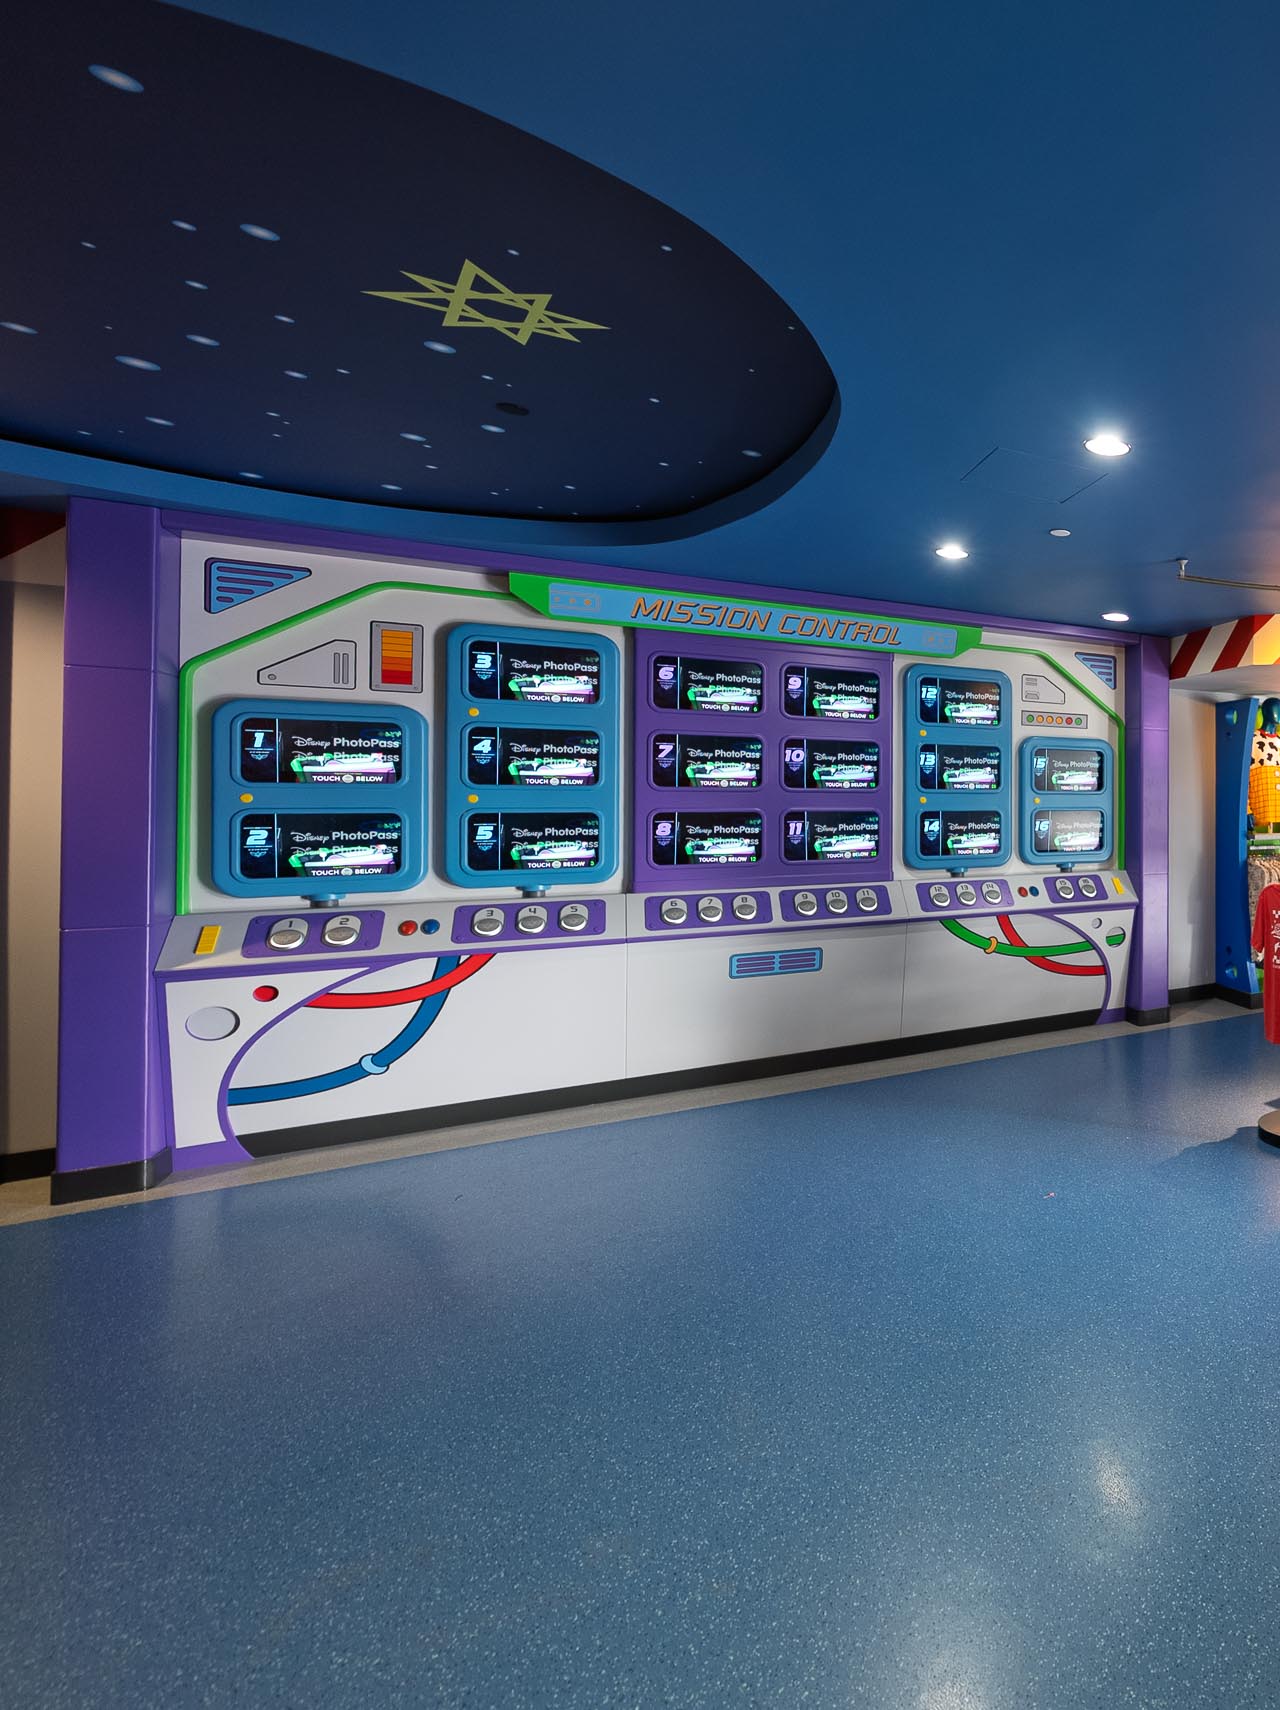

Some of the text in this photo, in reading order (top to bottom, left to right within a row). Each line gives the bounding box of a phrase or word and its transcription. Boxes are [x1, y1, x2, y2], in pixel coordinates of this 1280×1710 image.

[631, 597, 901, 645] MISSION CONTROL
[474, 654, 492, 669] 3
[510, 658, 598, 672] Disney PhotoPass
[658, 667, 675, 680] 6
[687, 671, 761, 684] Disney PhotoPass
[788, 677, 801, 690] 9
[813, 681, 877, 693] Disney PhotoPass
[527, 694, 550, 702] TOUCH
[921, 687, 938, 699] 12
[965, 692, 999, 700] PhotoPass
[254, 733, 264, 747] 1
[291, 736, 399, 749] Disney PhotoPass
[473, 739, 492, 753] 4
[509, 742, 598, 755] Disney PhotoPass
[657, 745, 673, 757] 7
[686, 748, 760, 759] Disney PhotoPass
[785, 749, 804, 762] 10
[813, 752, 877, 763] Disney PhotoPass
[920, 754, 935, 766] 13
[964, 757, 998, 765] PhotoPass
[1033, 757, 1046, 768] 15
[656, 823, 672, 835] 8
[685, 825, 759, 836] Disney PhotoPass
[789, 823, 802, 835] 11
[814, 824, 837, 834] Disney
[924, 821, 939, 832] 14
[1035, 821, 1049, 831] 16
[246, 830, 268, 845] 2
[290, 831, 398, 843] Disney PhotoPass
[475, 825, 494, 840] 5
[511, 827, 599, 839] Disney PhotoPass
[287, 920, 293, 929] 1
[339, 918, 349, 926] 2
